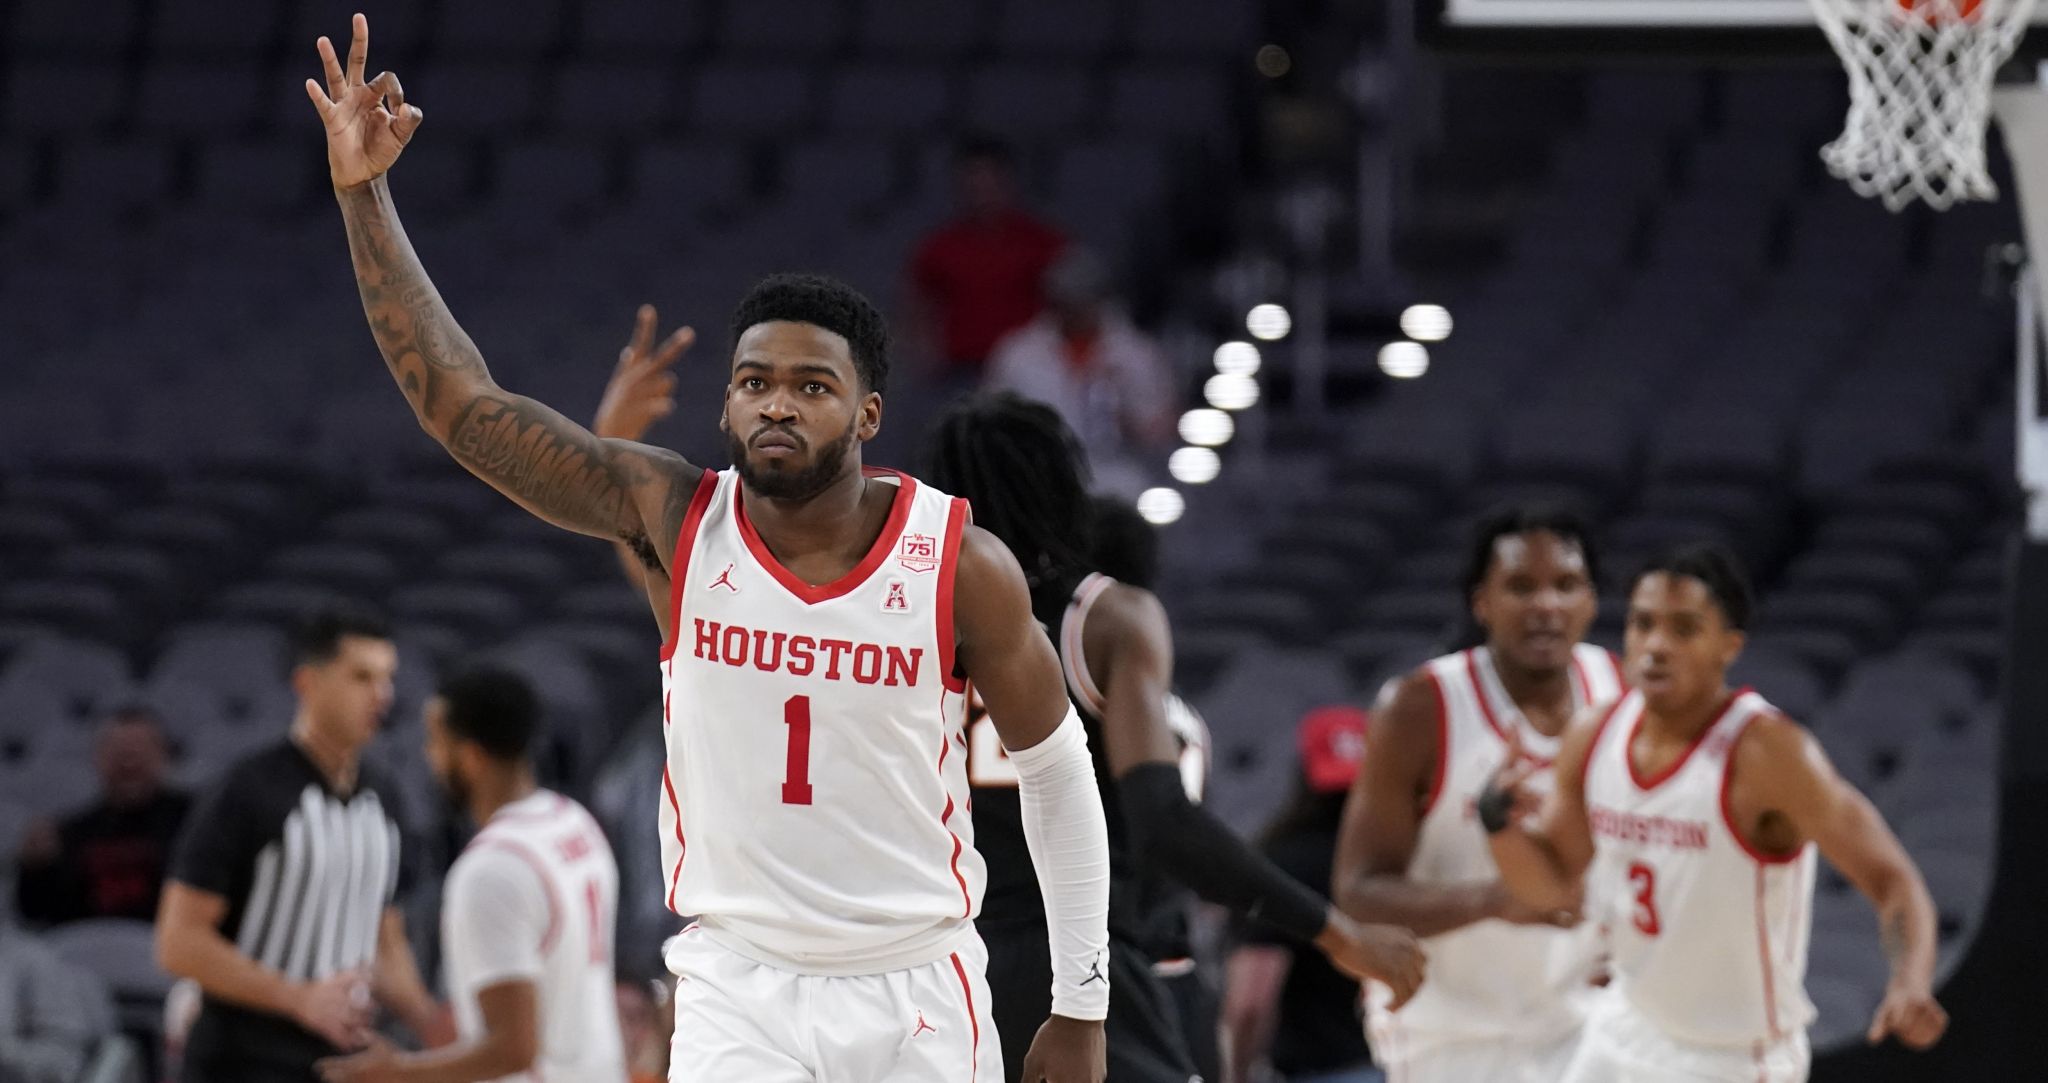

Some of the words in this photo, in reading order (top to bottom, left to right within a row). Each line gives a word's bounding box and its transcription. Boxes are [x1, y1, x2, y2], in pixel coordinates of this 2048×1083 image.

[907, 542, 931, 556] 75
[694, 618, 923, 687] HOUSTON
[781, 695, 812, 805] 1
[1629, 862, 1661, 937] 3
